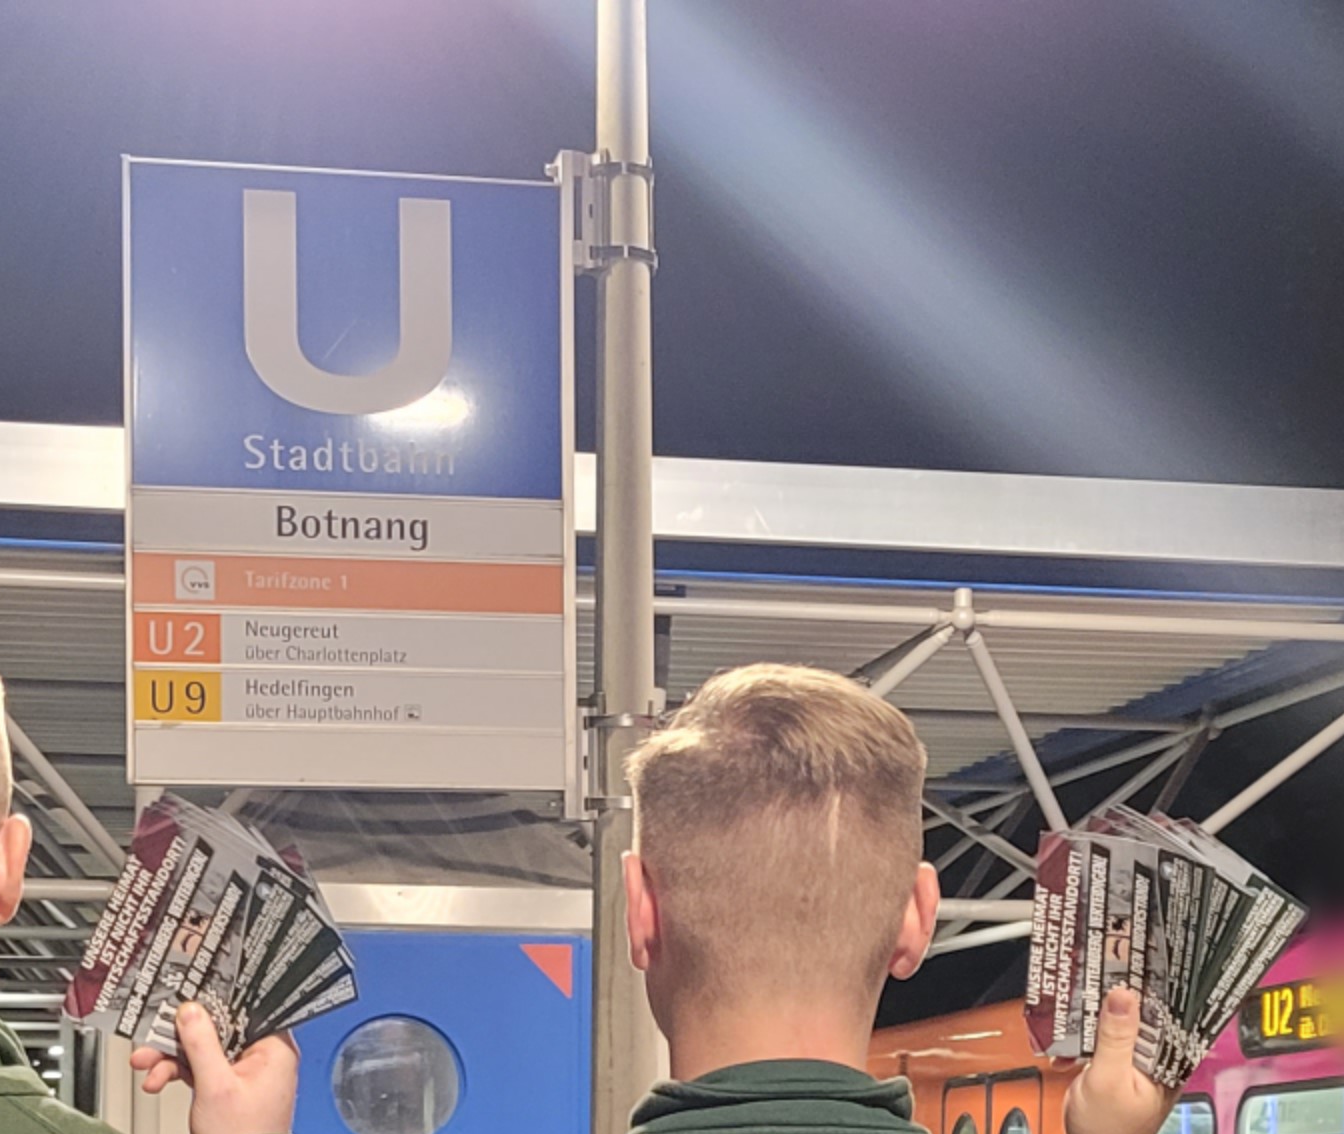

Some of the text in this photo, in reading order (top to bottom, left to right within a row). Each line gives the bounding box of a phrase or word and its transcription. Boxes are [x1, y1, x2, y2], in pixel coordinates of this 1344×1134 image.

[243, 189, 453, 415] U
[243, 435, 454, 475] Stadtbahn
[277, 506, 428, 550] Botnang
[244, 570, 348, 590] Tarifzone 1
[245, 620, 339, 642] Neugereut
[245, 645, 407, 666] über Charlottenplatz
[245, 679, 355, 701] Hedelfingen
[245, 704, 399, 724] über Hauptbahnhof
[81, 853, 141, 970] UNSERE HEIMAT
[93, 835, 186, 1012] WIRTSCHAFTSSTANDORT!
[99, 867, 152, 965] IST NICHT IHR
[1026, 884, 1048, 1004] UNSERE HEIMAT
[1041, 893, 1061, 995] IST NICHT IHR
[1052, 850, 1082, 1039] WIRTSCHAFTSSTANDORT!
[1130, 951, 1143, 974] DEN
[118, 914, 177, 1035] BADEN-WÜRTTEMBERG
[1262, 987, 1294, 1037] U2
